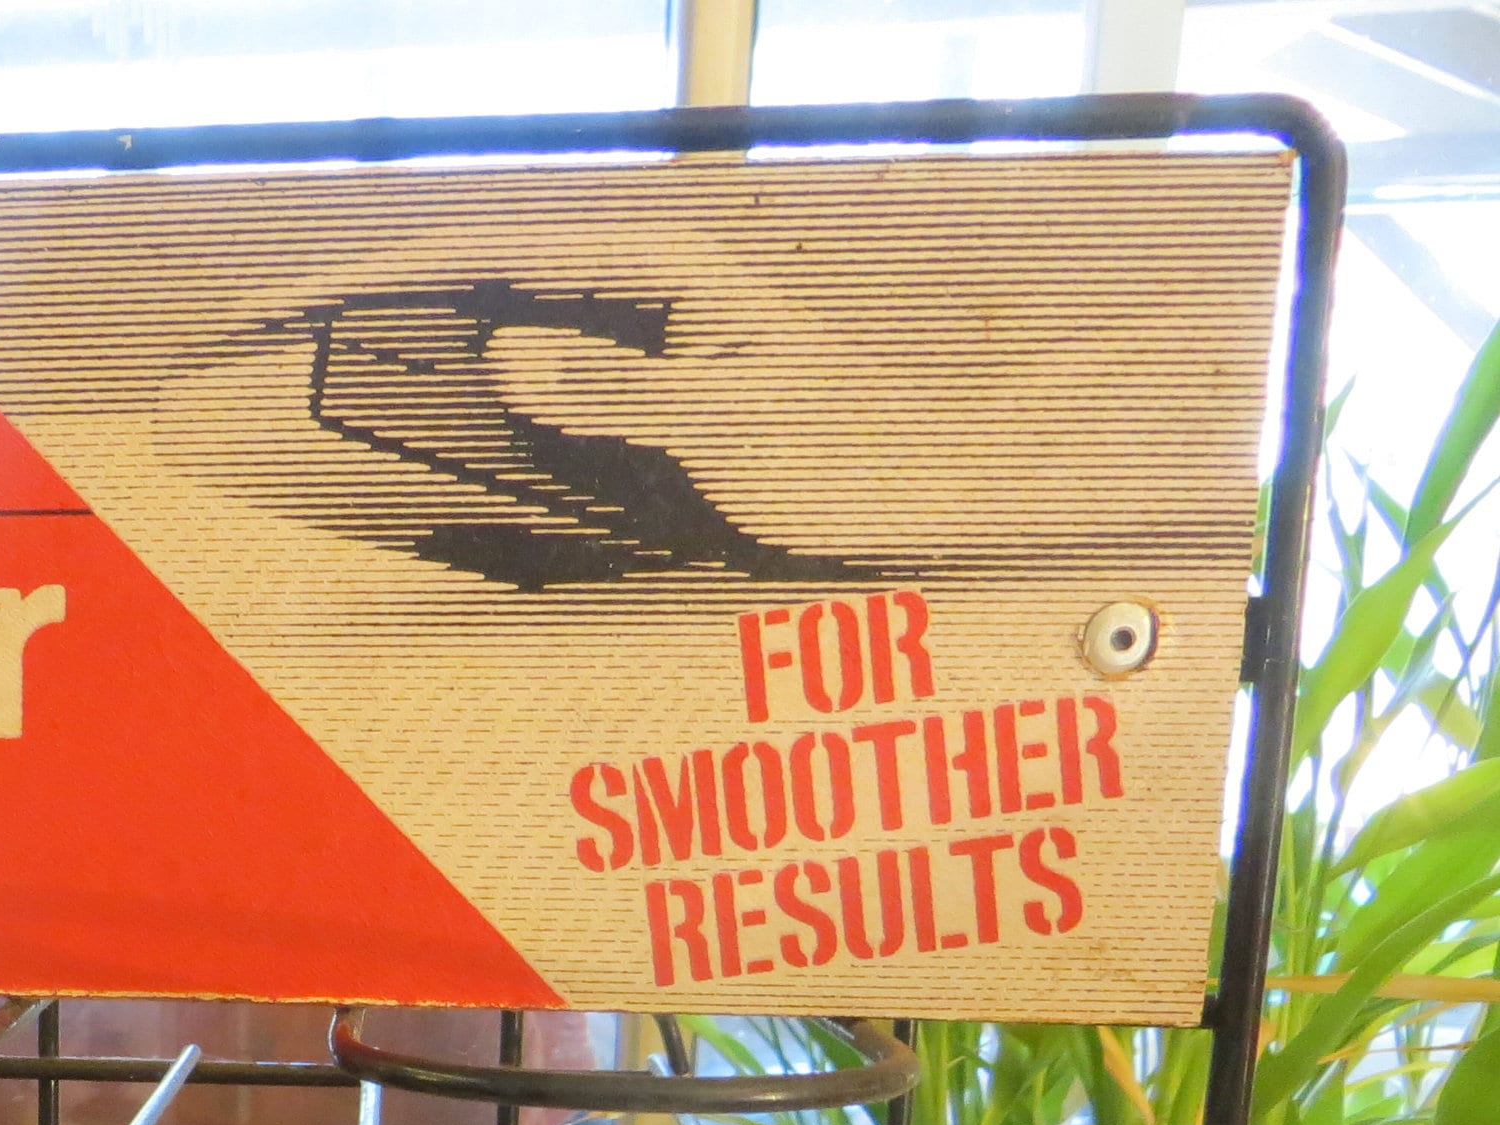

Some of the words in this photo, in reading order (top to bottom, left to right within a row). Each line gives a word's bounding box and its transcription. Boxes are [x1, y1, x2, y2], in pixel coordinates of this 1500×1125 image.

[737, 590, 935, 724] FOR
[569, 696, 1124, 873] SMOOTHER
[645, 826, 1084, 987] RESULTS
